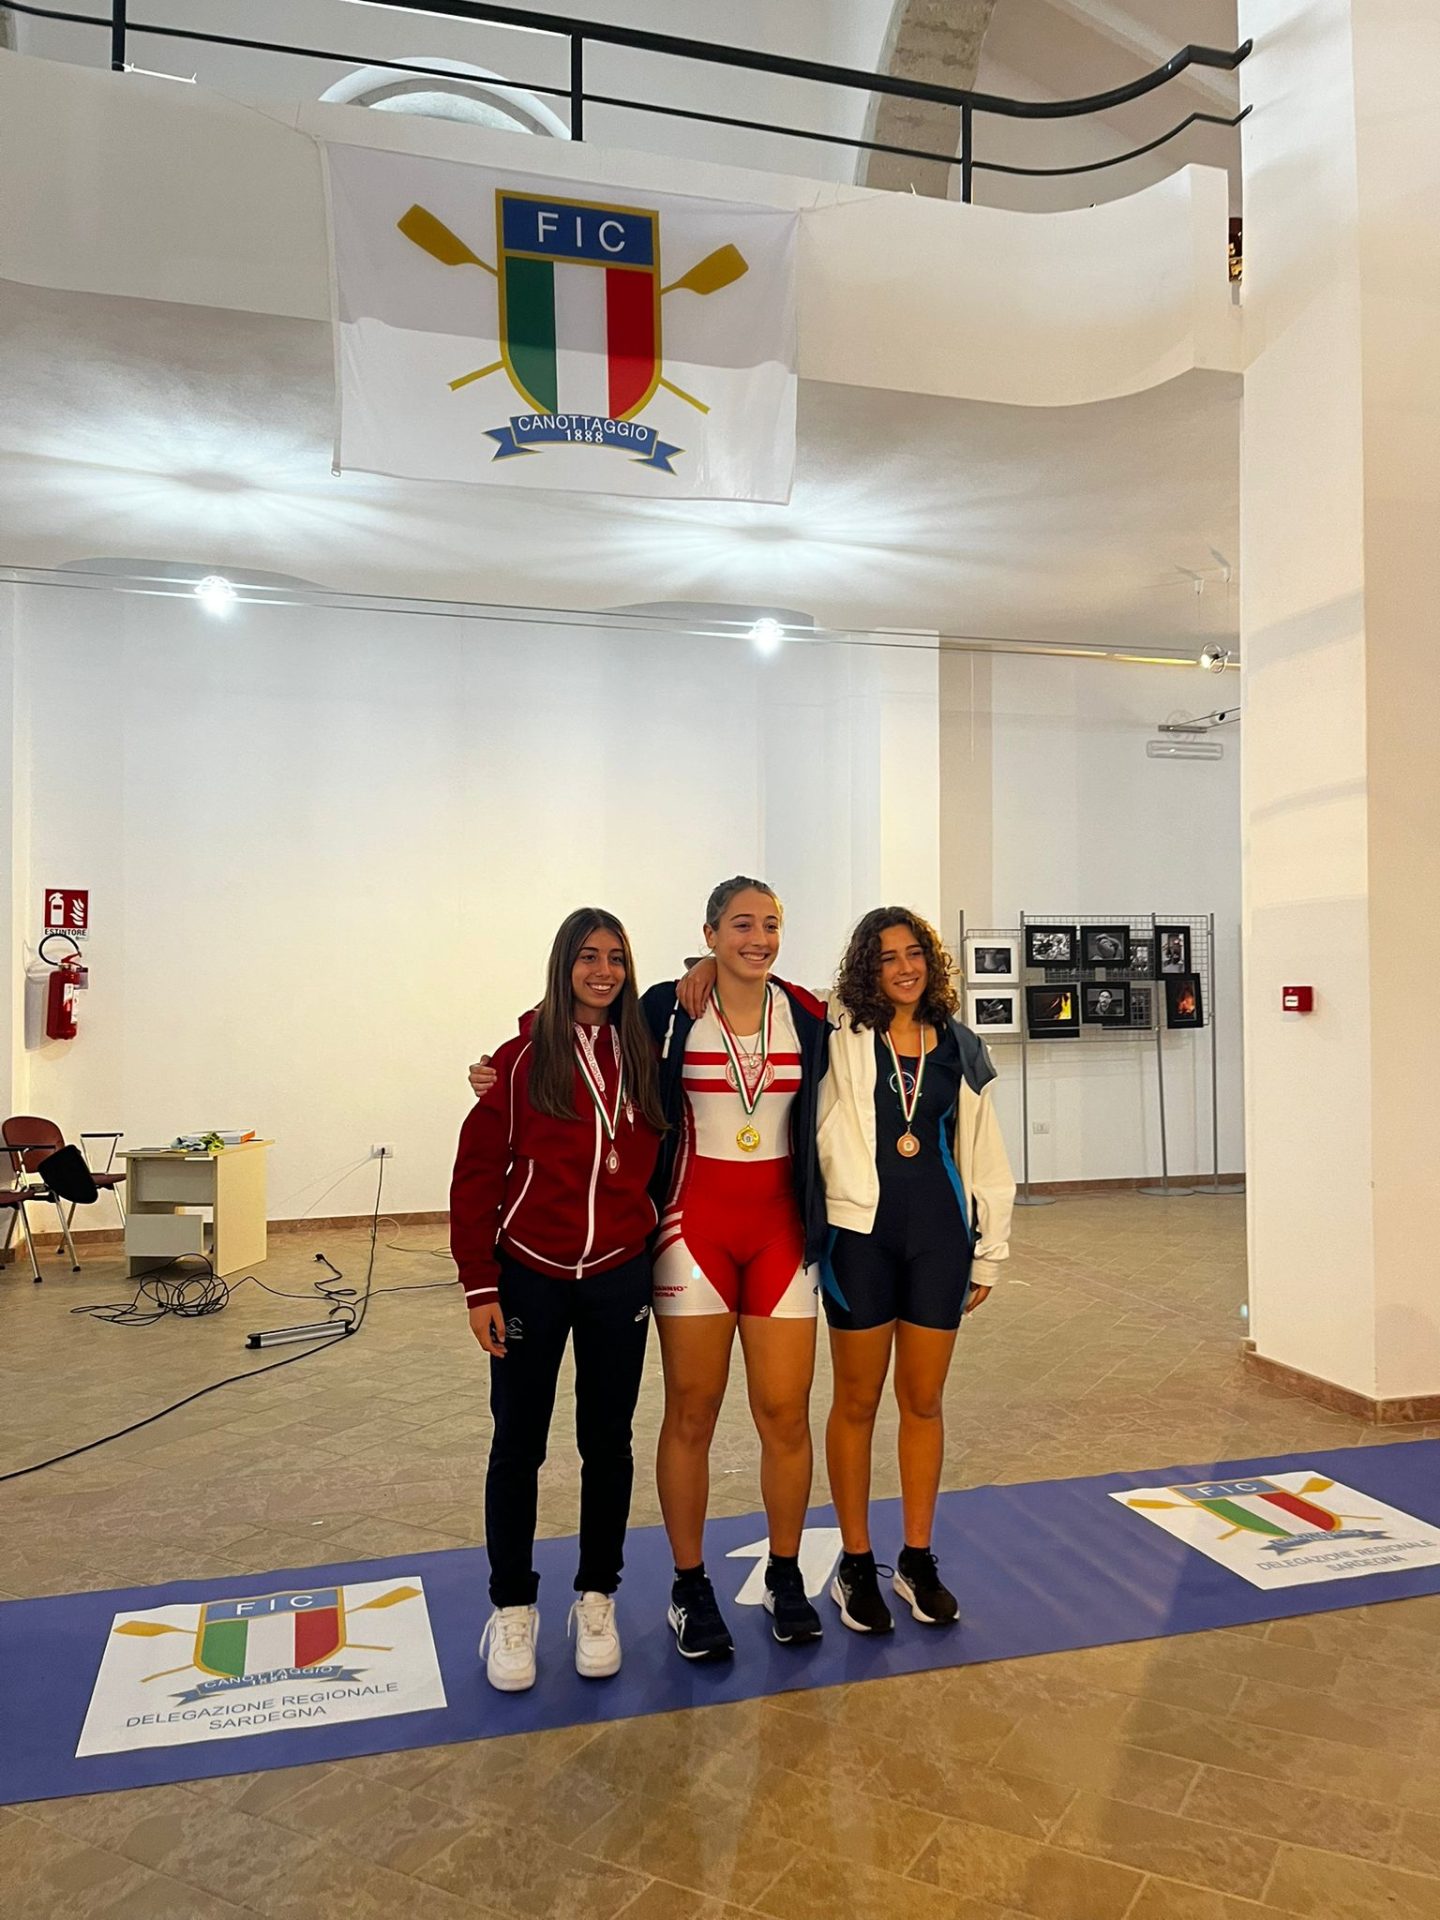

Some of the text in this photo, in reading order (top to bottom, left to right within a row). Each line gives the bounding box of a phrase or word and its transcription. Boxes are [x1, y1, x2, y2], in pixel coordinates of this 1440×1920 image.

[537, 211, 626, 253] FIC
[517, 415, 649, 442] CANOTTAGGIO
[565, 429, 604, 444] 1888
[44, 928, 87, 936] ESTINTORE
[1197, 1483, 1257, 1497] FIC
[1256, 1539, 1437, 1571] DELEGAZIONE REGIONALE
[1325, 1554, 1408, 1572] SARDEGNA
[236, 1594, 315, 1616] FIC
[204, 1665, 334, 1689] CANOTTAGGIO
[125, 1682, 399, 1728] DELEGAZIONE REGIONALE
[208, 1705, 327, 1731] SARDEGNA
